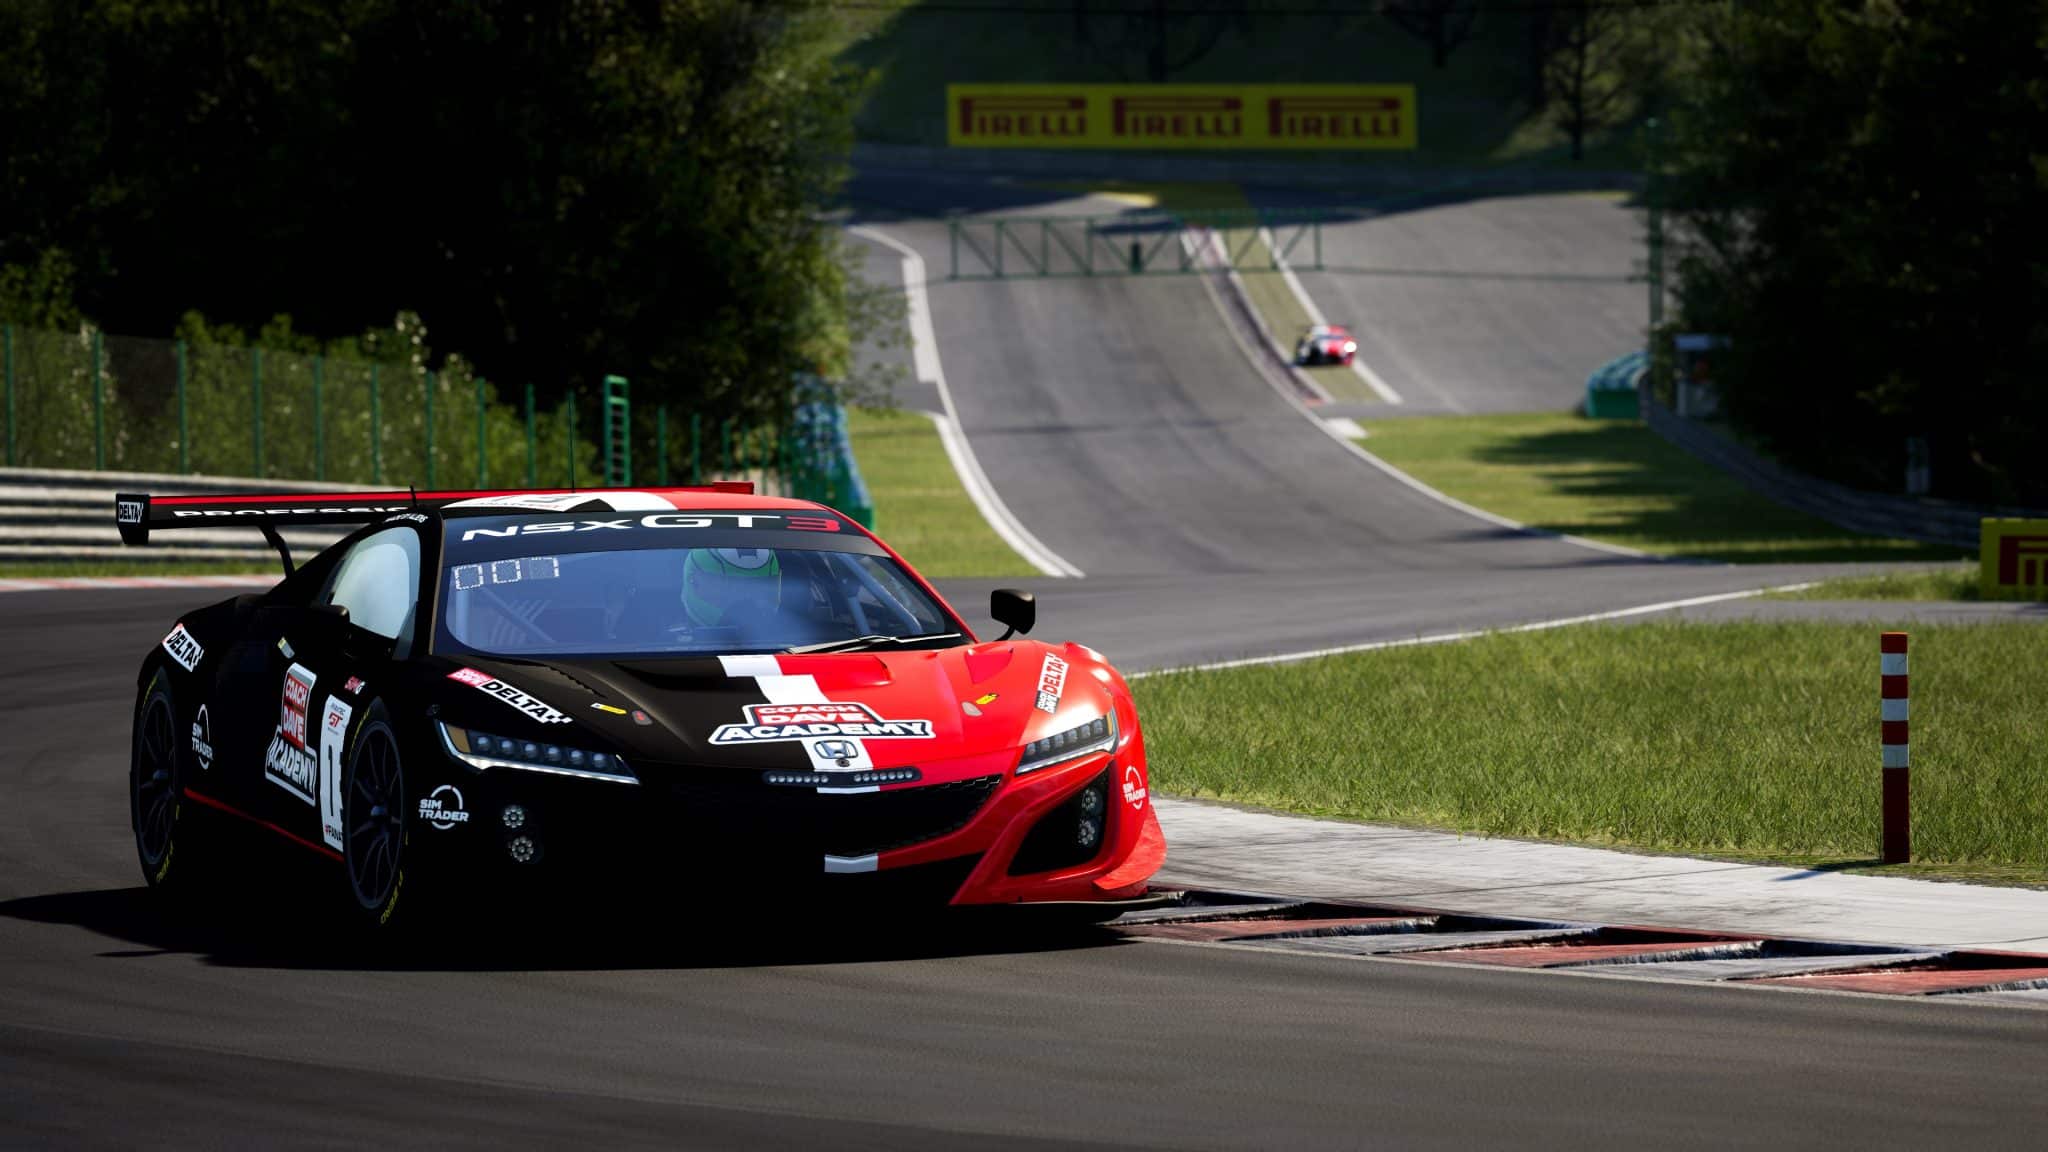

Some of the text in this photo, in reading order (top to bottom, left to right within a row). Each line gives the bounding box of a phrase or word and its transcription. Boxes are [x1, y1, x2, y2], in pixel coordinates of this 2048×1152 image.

[959, 96, 1401, 136] PIRELLI PIRELLI PIRELLI
[1041, 660, 1065, 695] DELTA
[481, 681, 549, 718] DELTA
[758, 705, 861, 714] COACH
[283, 704, 304, 743] DAVE
[719, 722, 927, 741] ACADEMY
[760, 713, 870, 724] DAVE
[268, 736, 315, 793] ACADEMY
[418, 808, 469, 822] TRADER
[419, 798, 442, 810] SIM
